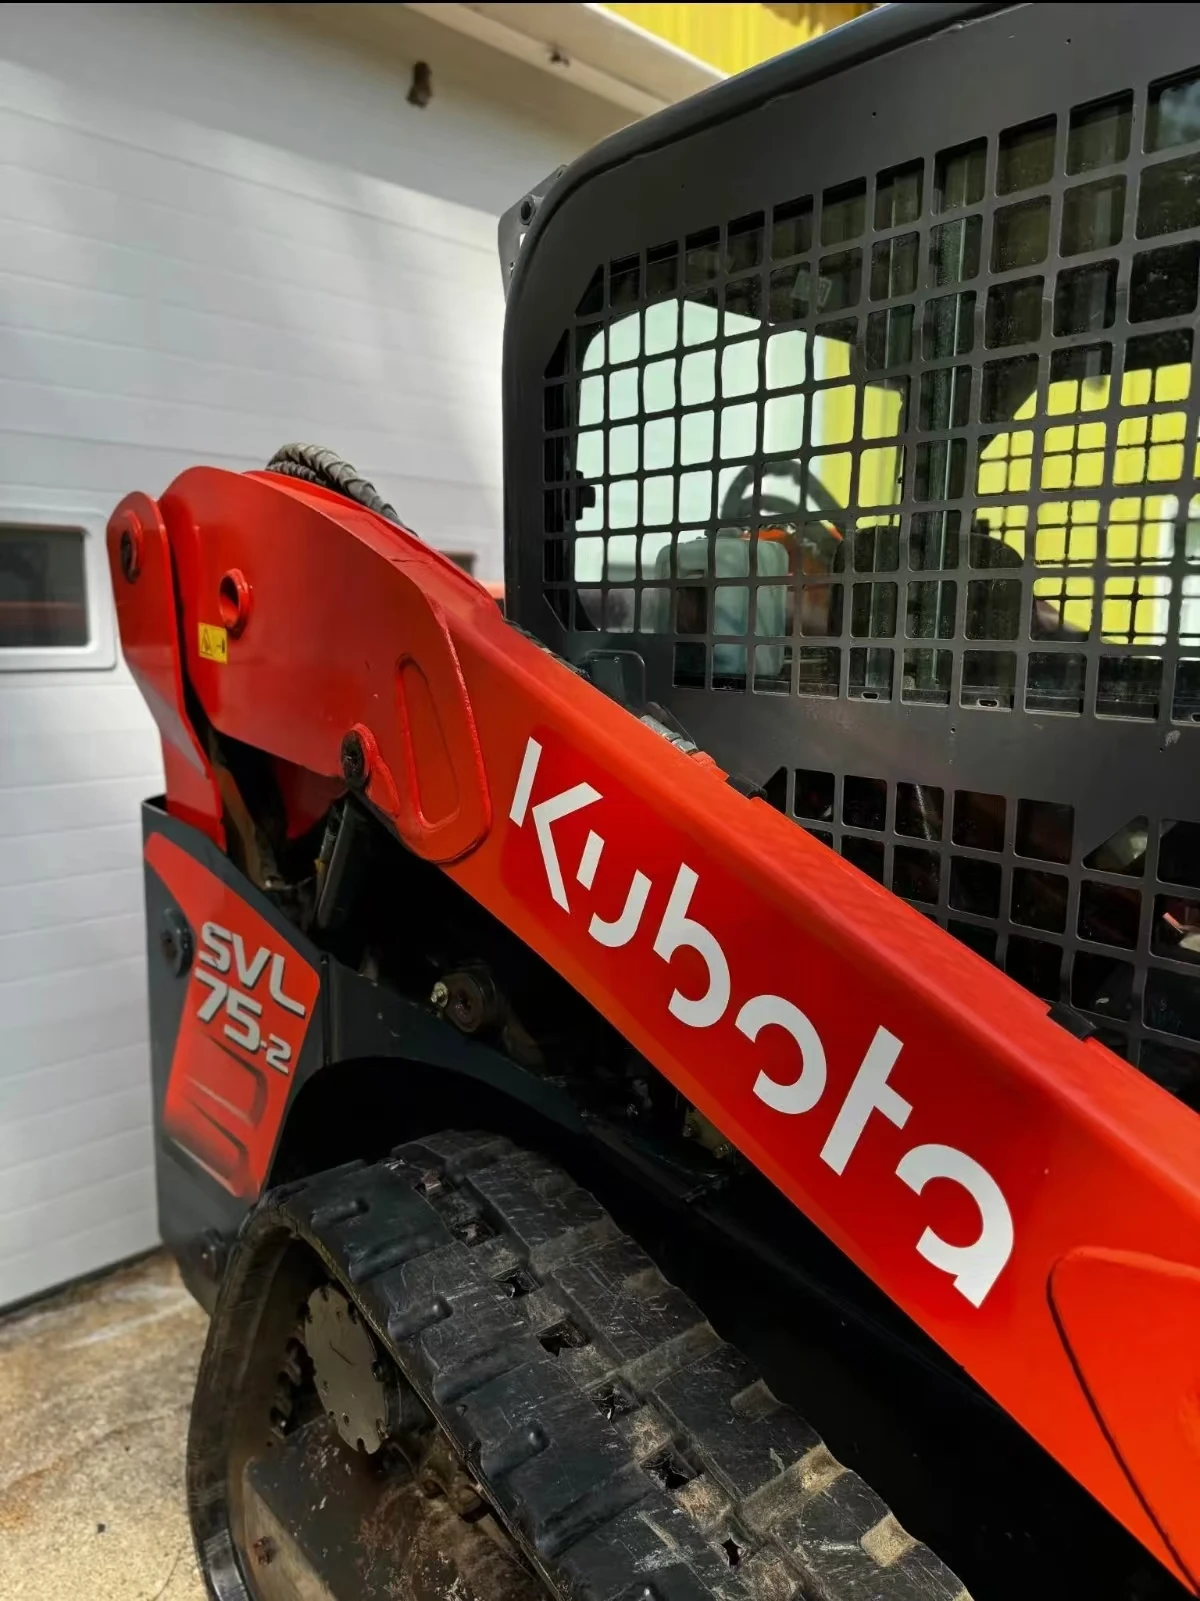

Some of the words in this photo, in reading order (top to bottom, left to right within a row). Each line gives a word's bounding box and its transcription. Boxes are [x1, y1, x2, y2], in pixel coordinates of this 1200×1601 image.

[195, 967, 292, 1075] 75-2
[198, 921, 306, 1017] SVL
[509, 736, 1014, 1308] Kubota
